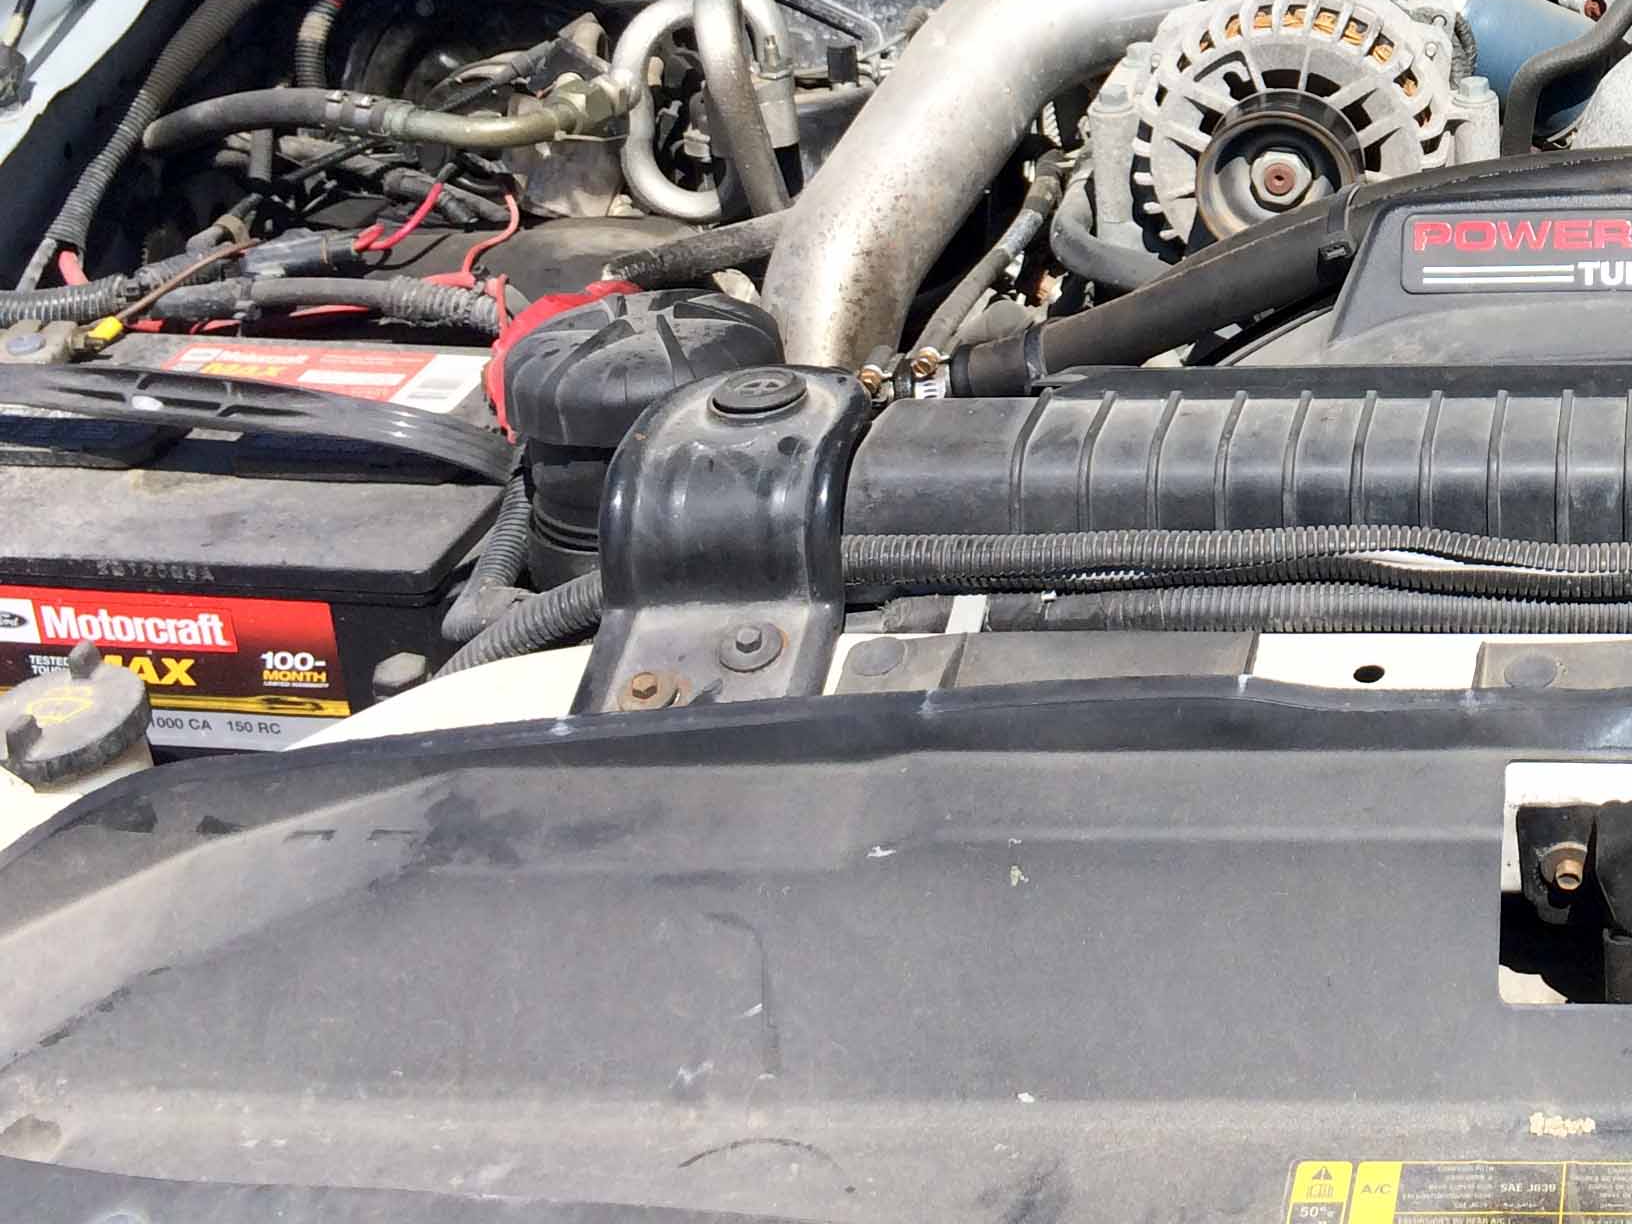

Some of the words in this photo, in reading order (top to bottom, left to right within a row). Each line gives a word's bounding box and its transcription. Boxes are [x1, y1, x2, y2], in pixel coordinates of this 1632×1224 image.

[1412, 218, 1632, 253] POWER
[40, 604, 226, 646] Motorcraft
[261, 651, 327, 671] 100-
[263, 670, 327, 683] MONTH
[189, 719, 212, 731] CA
[227, 721, 256, 733] 150
[258, 723, 281, 735] RC
[1361, 1183, 1393, 1194] A/C
[1500, 1183, 1523, 1193] SAE
